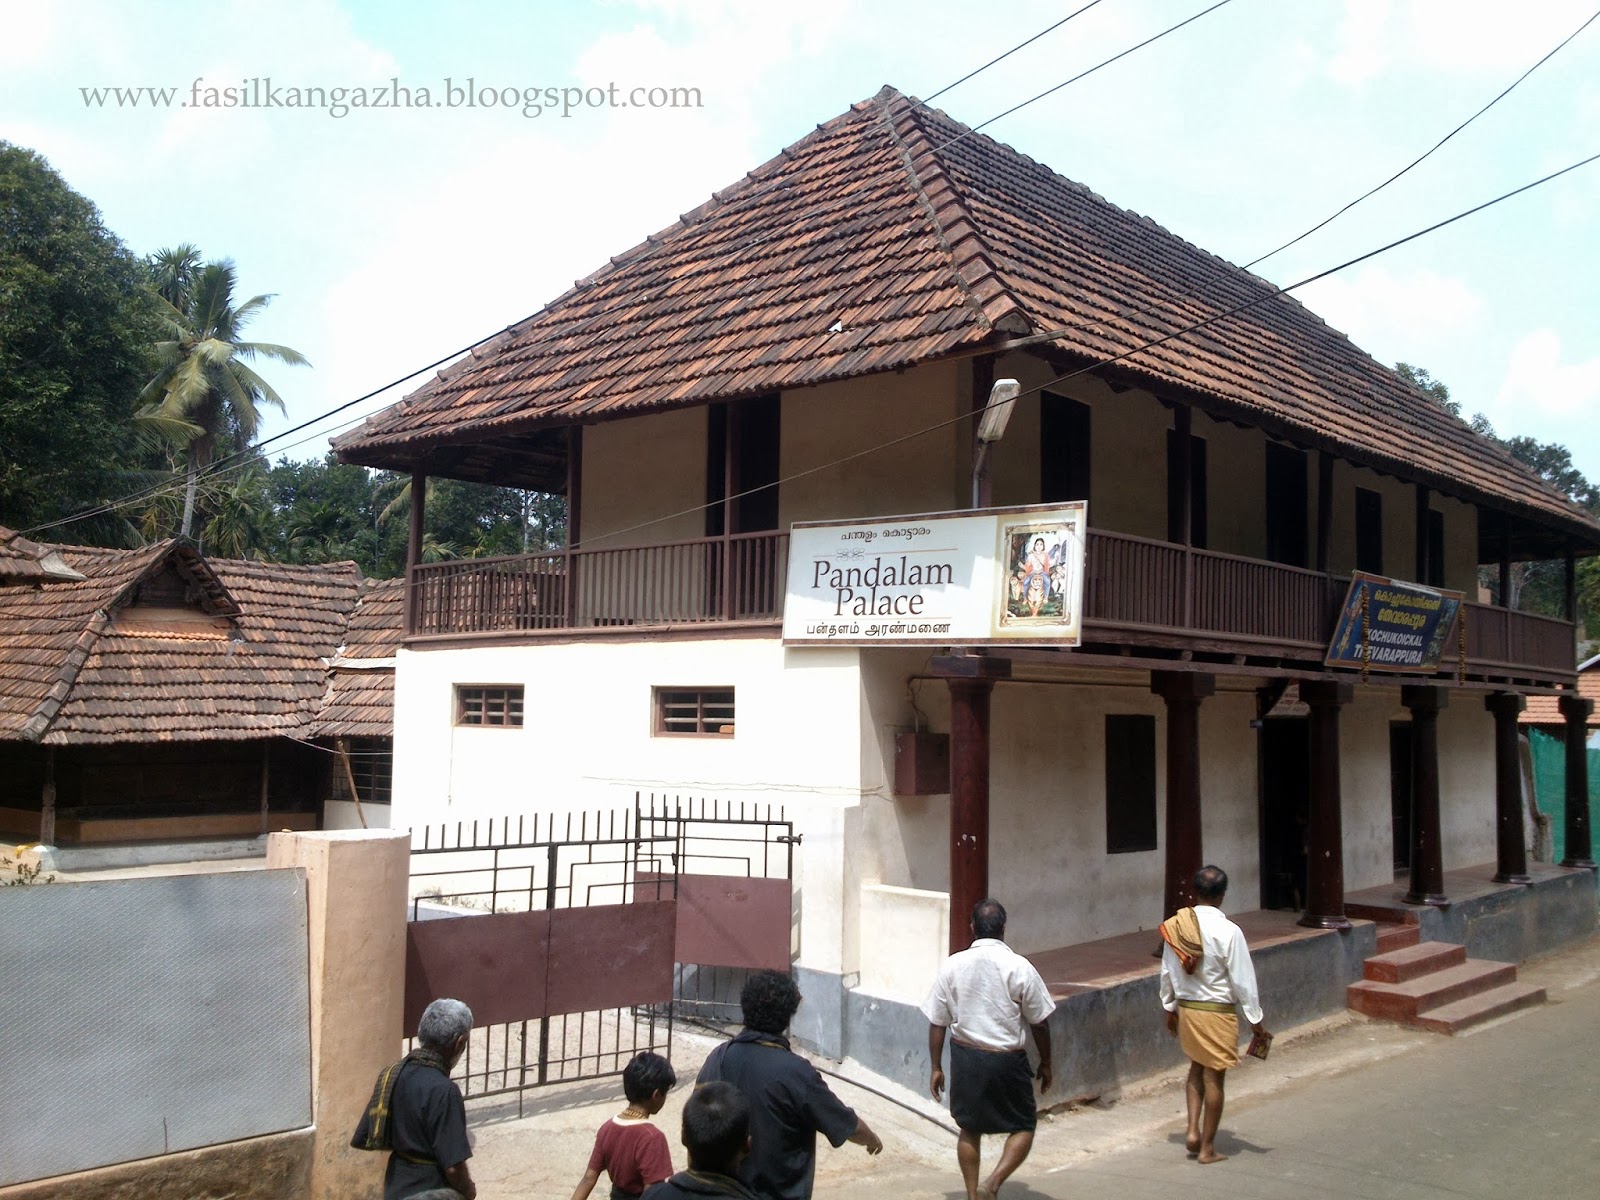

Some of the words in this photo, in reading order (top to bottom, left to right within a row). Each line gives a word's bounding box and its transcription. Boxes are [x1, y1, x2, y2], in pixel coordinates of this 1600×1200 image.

[811, 556, 954, 589] Pandalam
[834, 585, 924, 617] Palace
[1367, 628, 1423, 646] KOCHUKOICKAL
